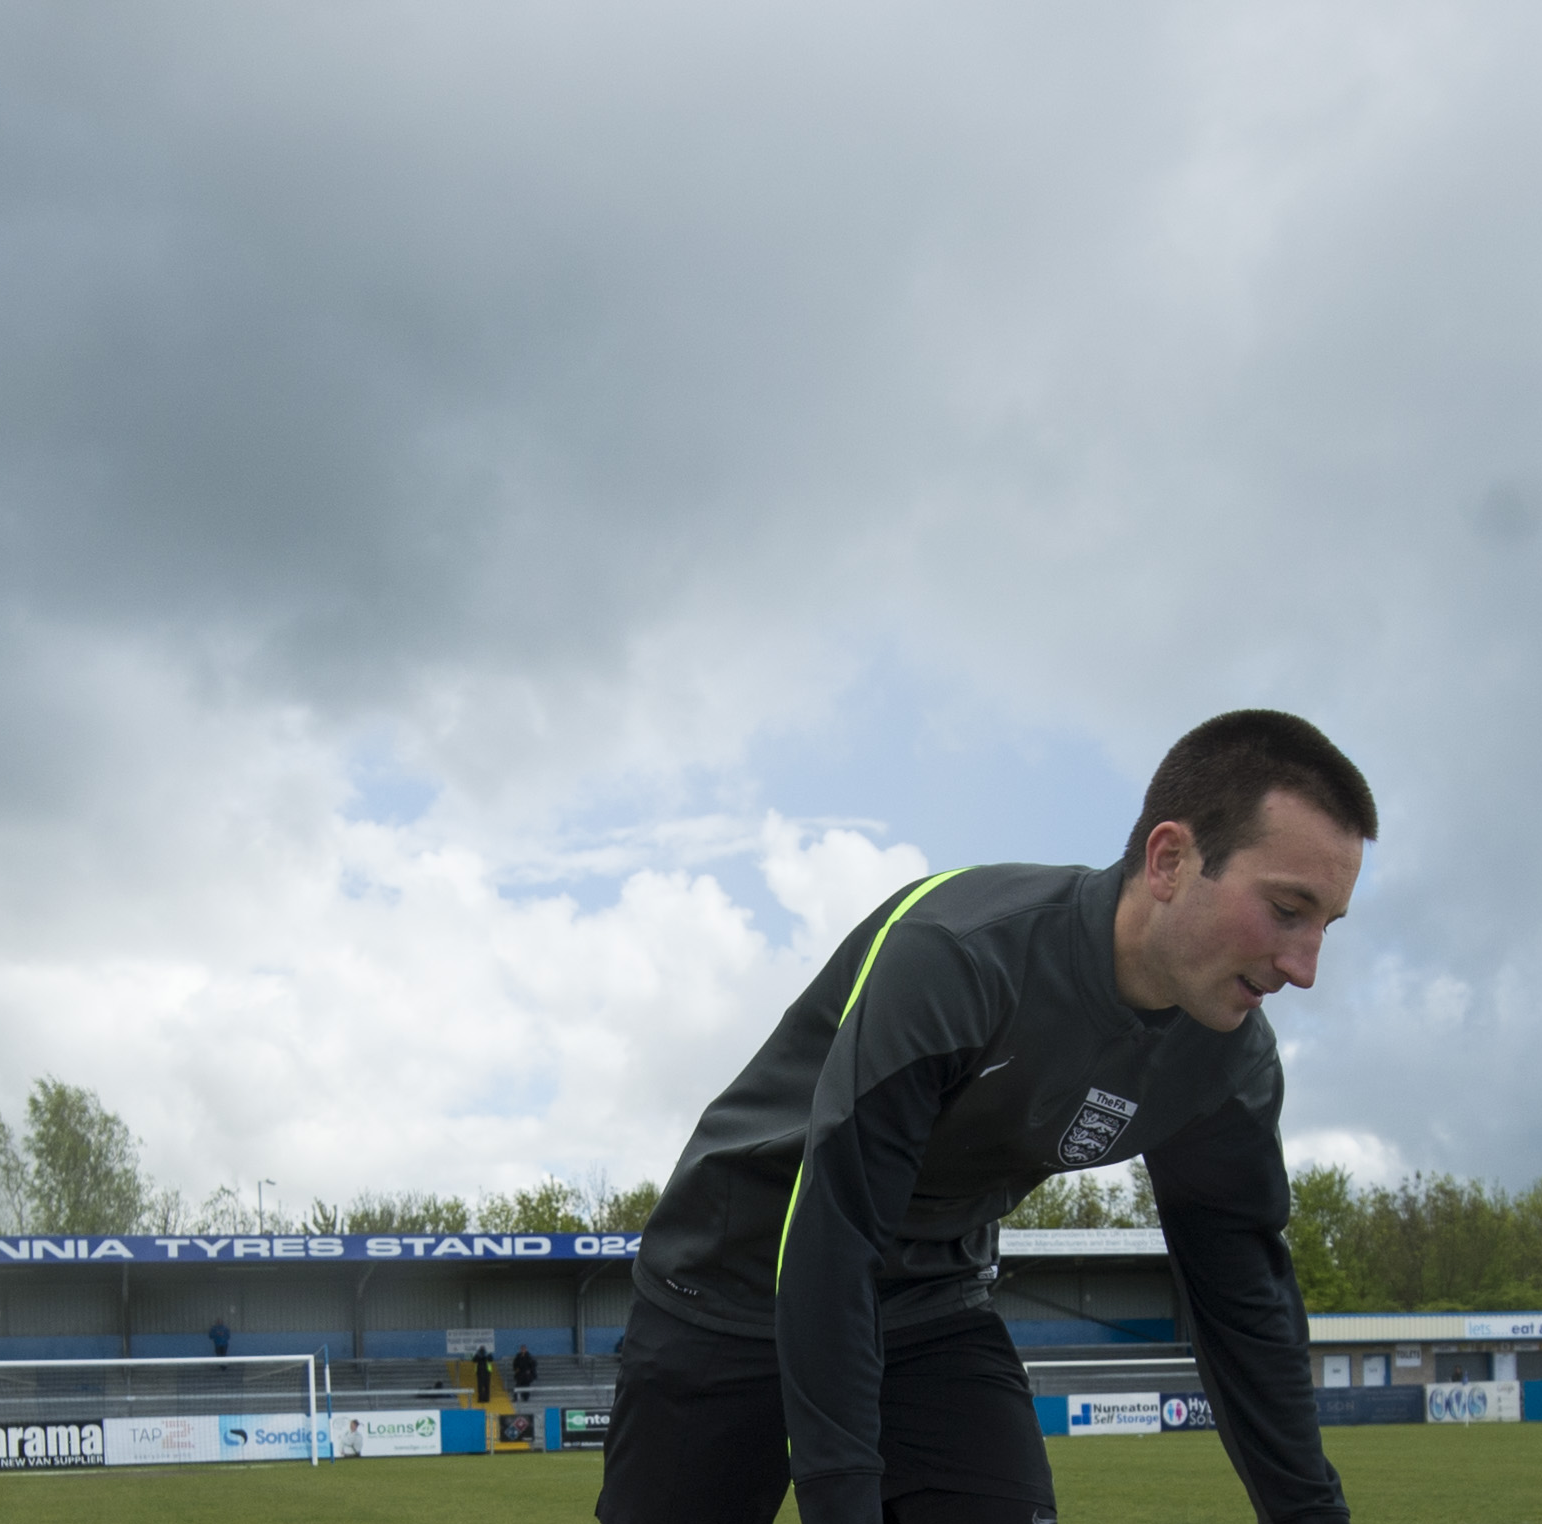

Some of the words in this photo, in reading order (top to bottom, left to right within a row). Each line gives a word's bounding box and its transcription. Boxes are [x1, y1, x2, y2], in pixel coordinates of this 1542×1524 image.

[365, 1236, 552, 1258] STAND
[574, 1235, 644, 1256] 024
[1511, 1321, 1535, 1336] eat
[1396, 1351, 1422, 1360] TOILETS
[1093, 1403, 1158, 1414] Nuneaton
[1094, 1412, 1115, 1425] Self
[1116, 1412, 1158, 1424] Storage
[367, 1421, 415, 1435] Loans
[129, 1427, 162, 1444] TAP
[0, 1457, 26, 1468] NEW
[27, 1456, 52, 1467] VAN
[53, 1454, 104, 1466] SUPPLIER
